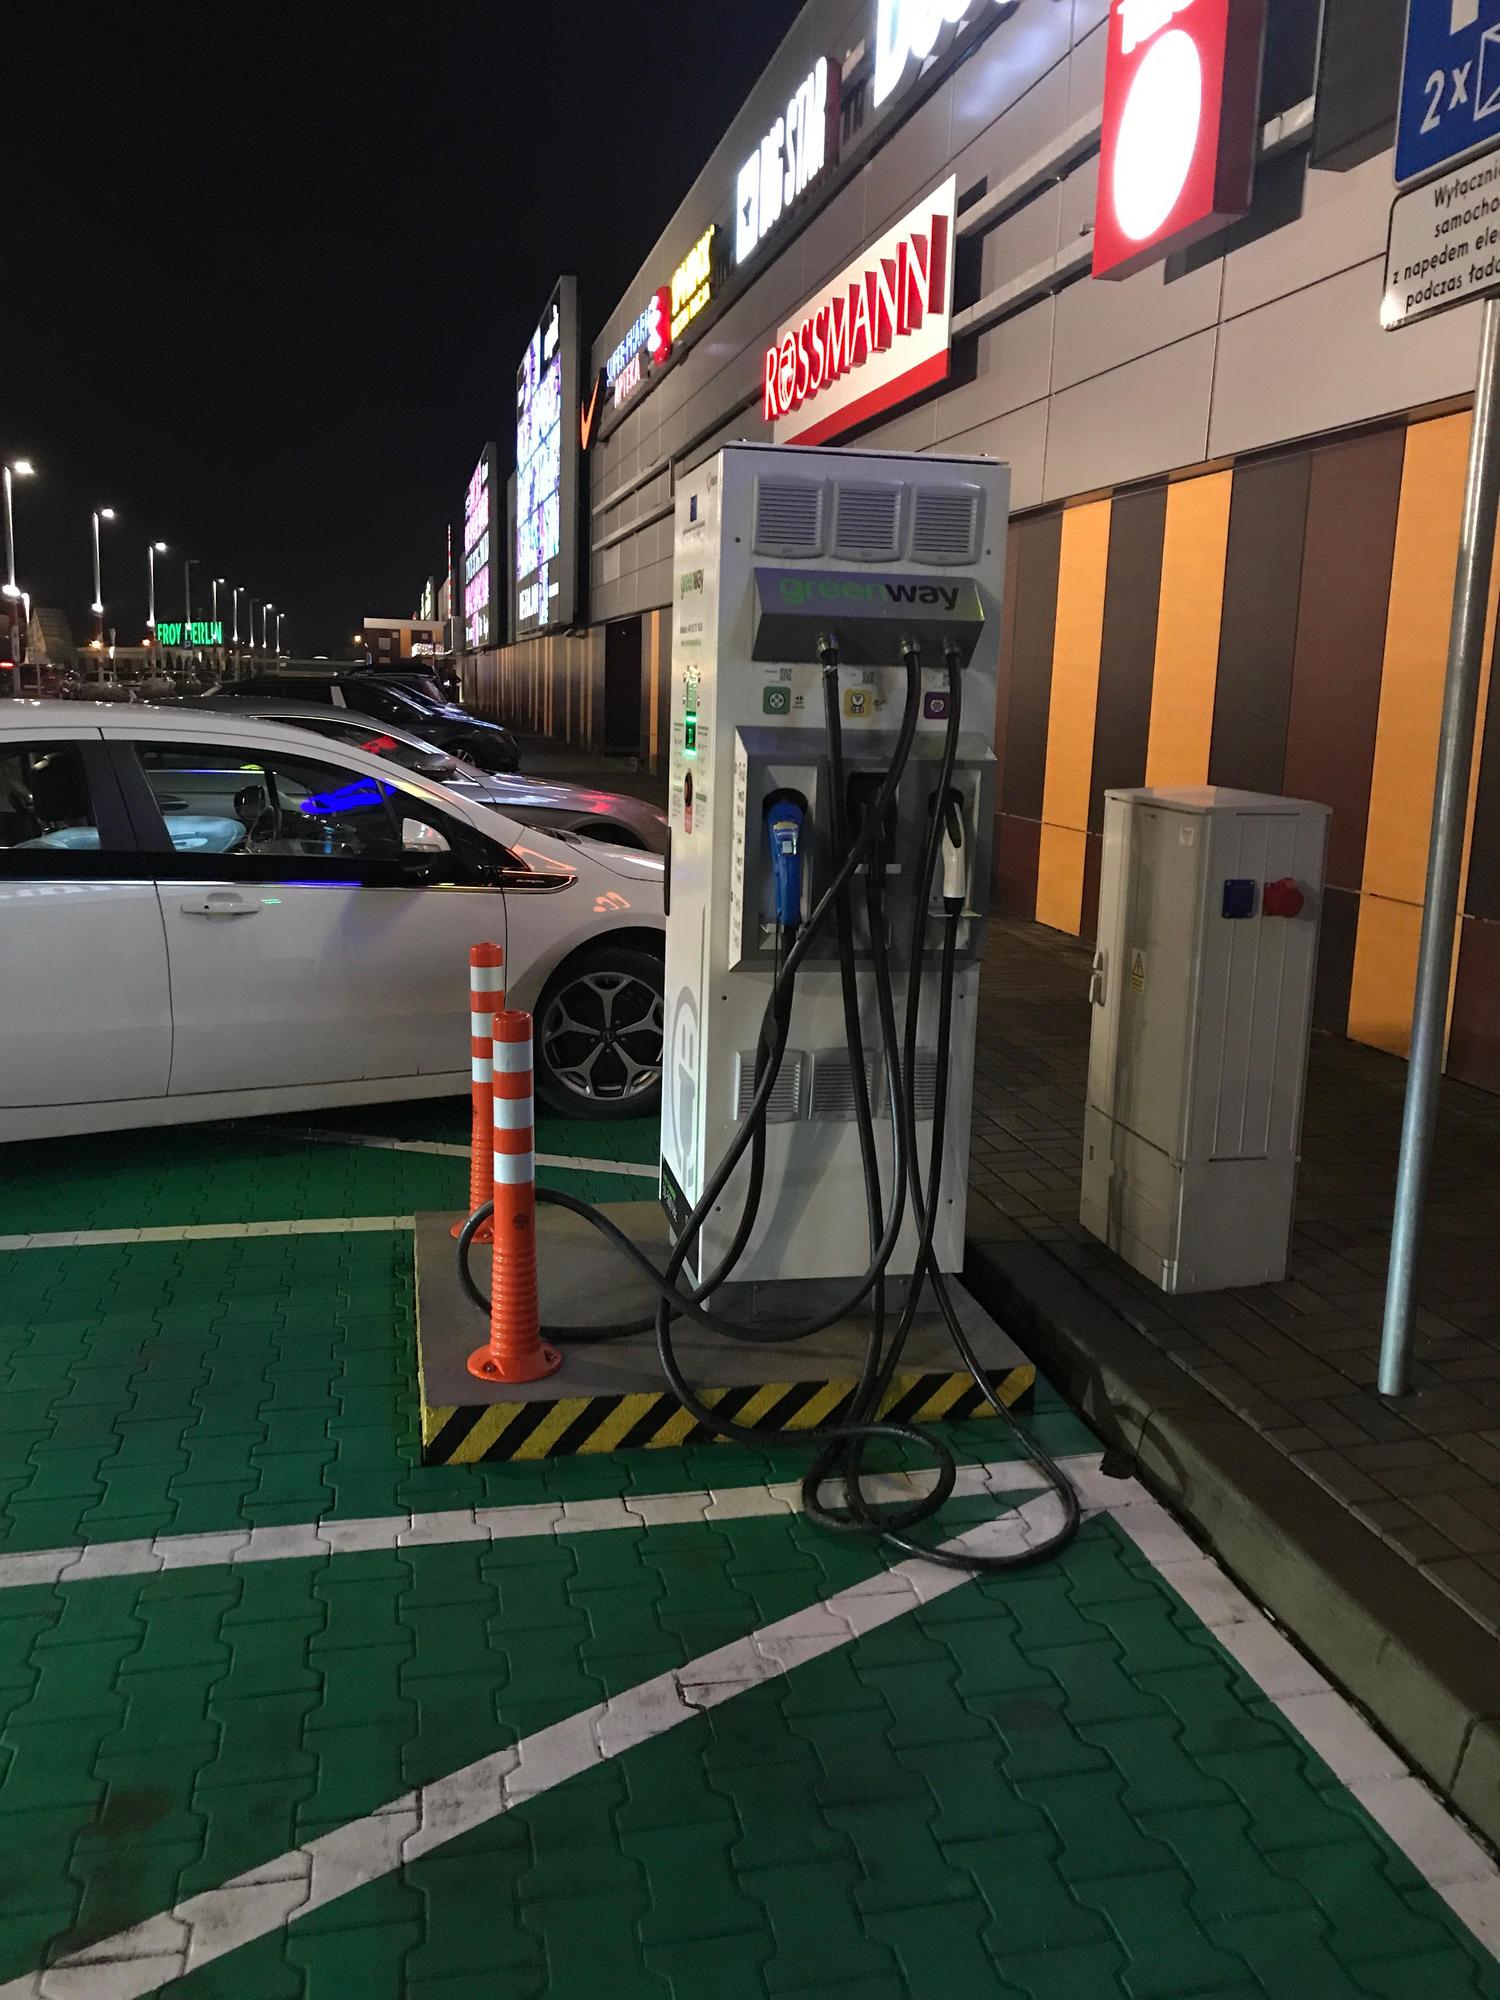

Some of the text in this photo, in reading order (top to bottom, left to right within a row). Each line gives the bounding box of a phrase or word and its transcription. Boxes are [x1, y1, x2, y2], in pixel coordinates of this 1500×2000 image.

[1434, 159, 1500, 208] Wyłączni
[1393, 226, 1500, 285] z napędem ele
[765, 214, 949, 421] ROSSMANN
[1406, 274, 1463, 314] podczas
[778, 577, 960, 611] greenway
